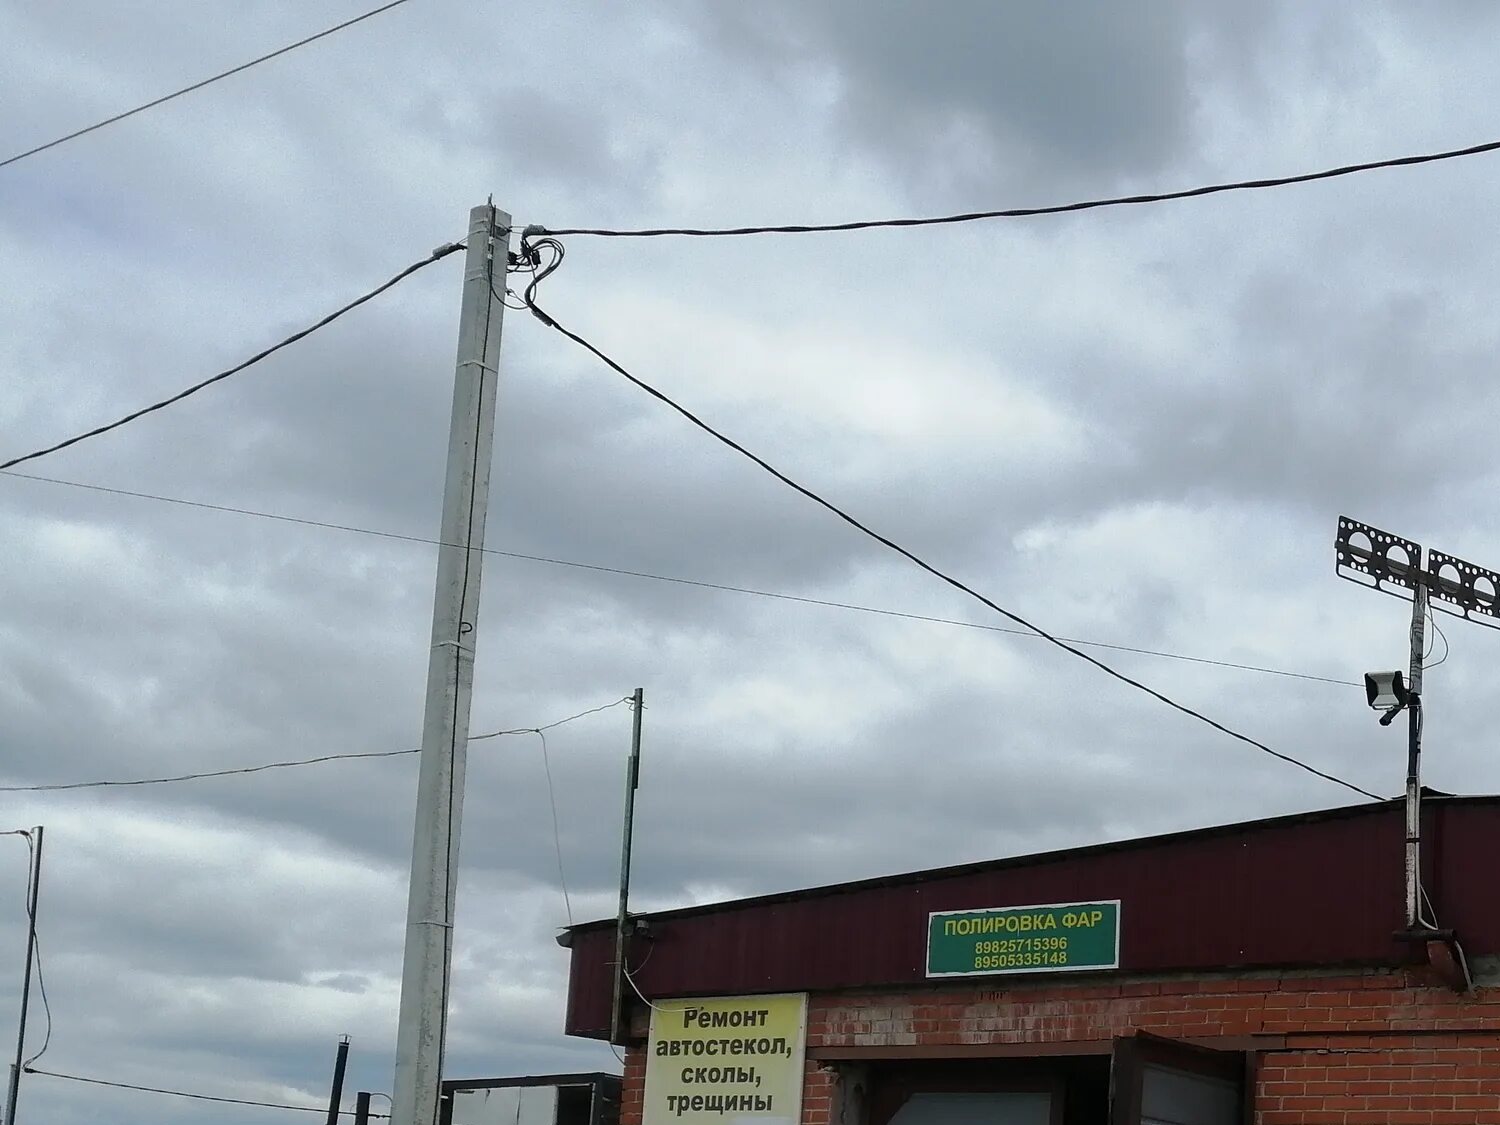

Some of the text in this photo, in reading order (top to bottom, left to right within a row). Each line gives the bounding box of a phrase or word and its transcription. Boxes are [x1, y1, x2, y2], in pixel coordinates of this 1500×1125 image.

[944, 911, 1103, 936] ПОЛИРОВКА ФАР
[975, 937, 1068, 954] 89825715396
[974, 952, 1067, 969] 89505335148
[683, 1006, 768, 1029] Ремонт
[656, 1036, 792, 1056] автостекол,
[681, 1066, 761, 1088] сколы,
[667, 1093, 773, 1116] трещины
